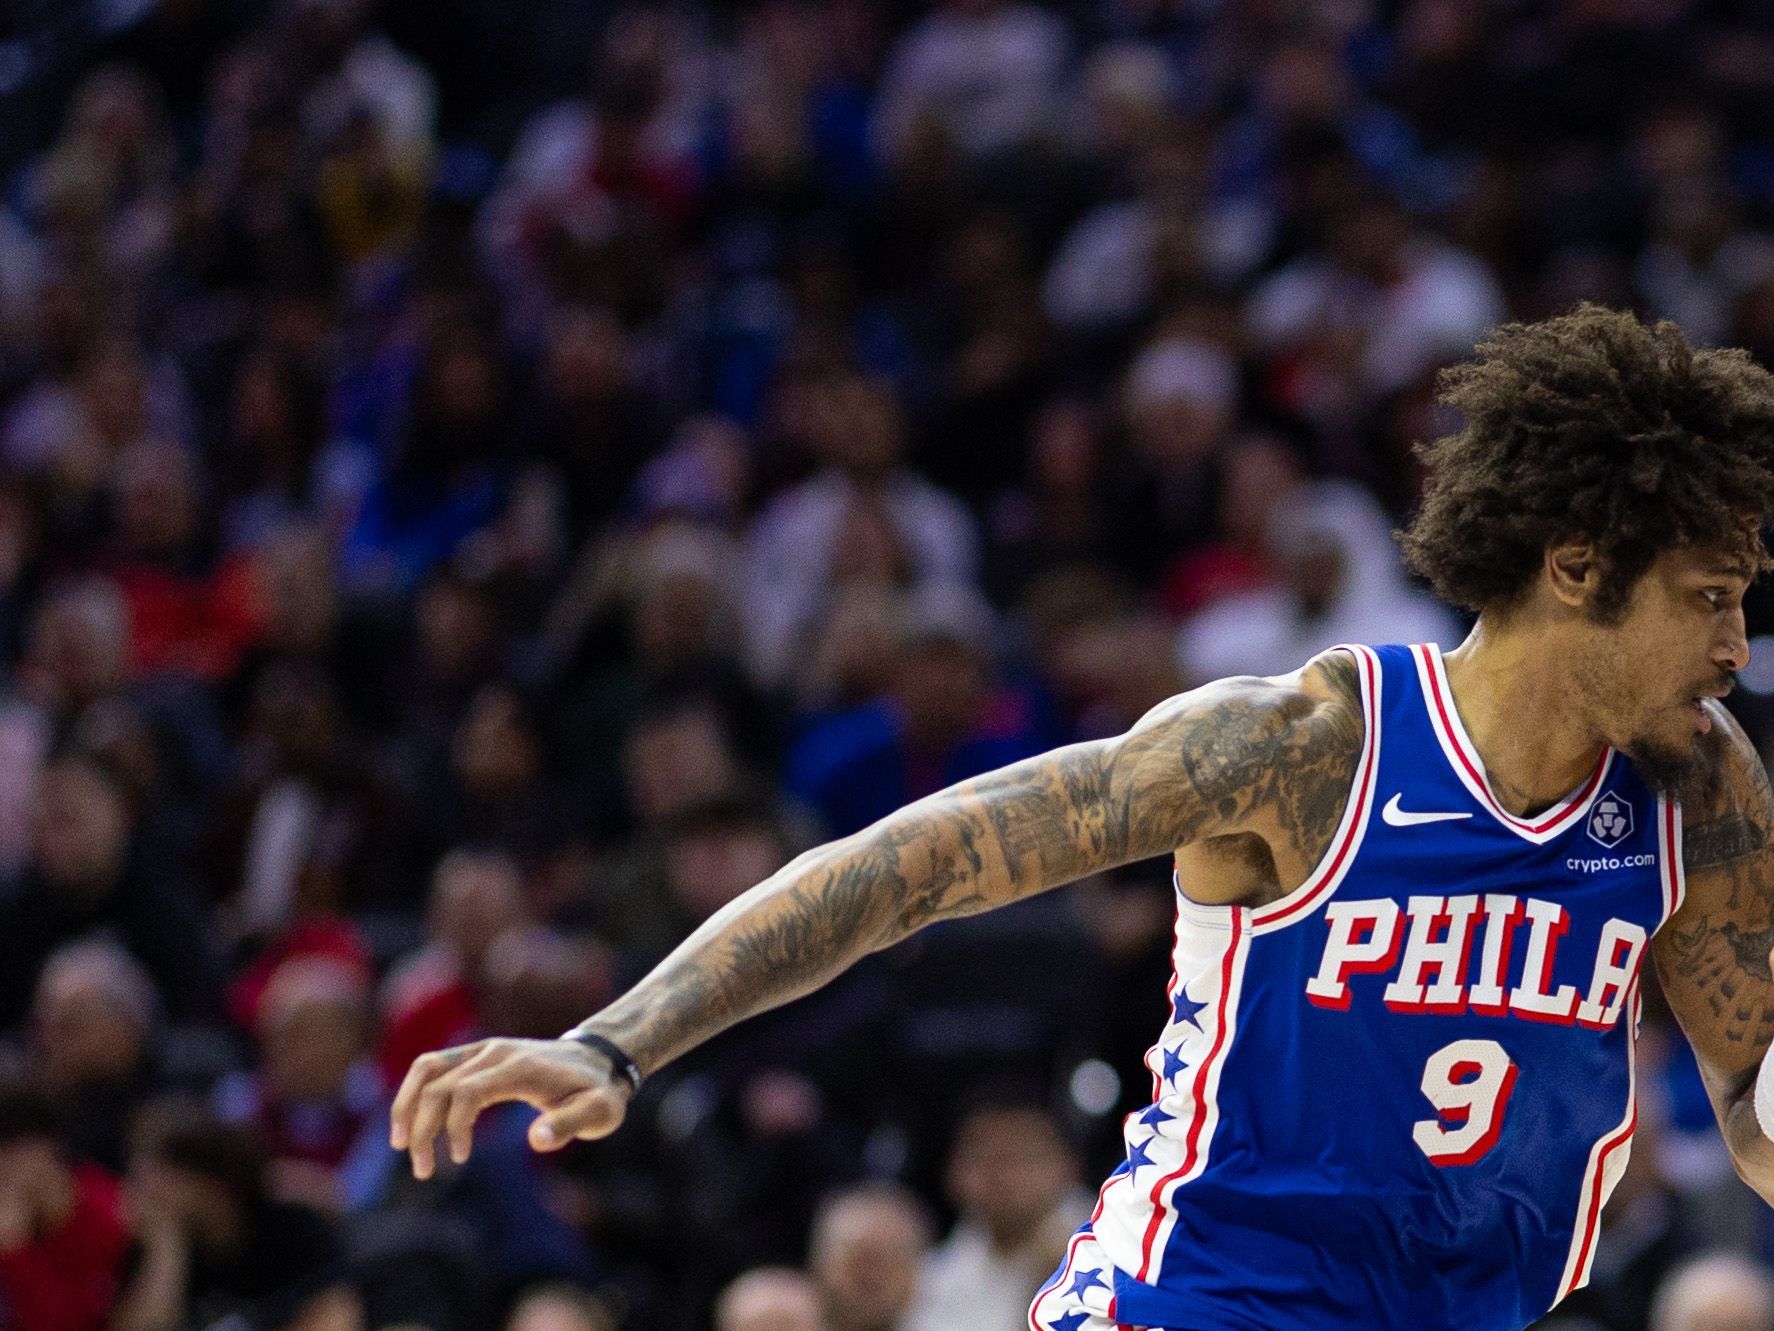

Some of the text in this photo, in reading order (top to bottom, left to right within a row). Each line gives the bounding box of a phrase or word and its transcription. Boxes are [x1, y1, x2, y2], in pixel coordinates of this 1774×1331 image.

[1566, 854, 1655, 873] crypto.com
[1306, 894, 1648, 1030] PHILA
[1412, 1039, 1519, 1168] 9
